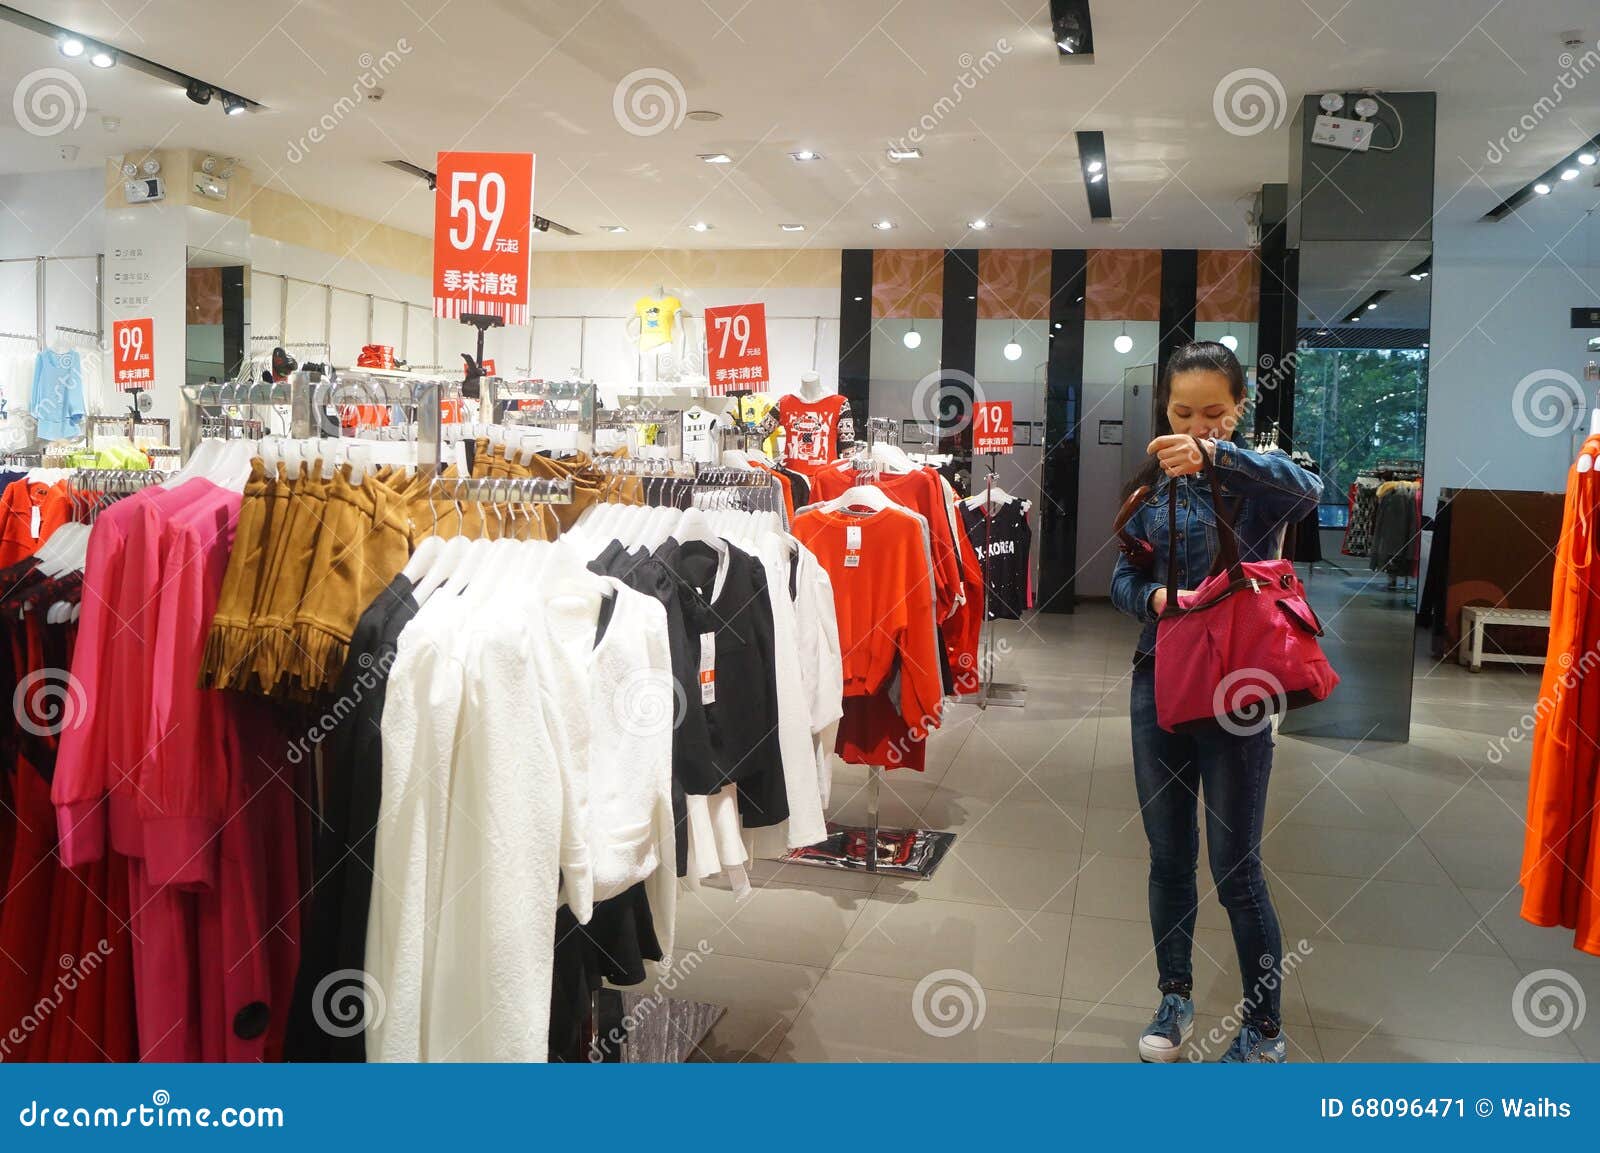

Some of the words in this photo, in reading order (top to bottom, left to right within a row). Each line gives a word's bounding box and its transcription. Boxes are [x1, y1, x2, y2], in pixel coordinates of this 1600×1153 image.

[449, 171, 506, 251] 59
[495, 238, 519, 253] 元起
[443, 269, 518, 296] 季末清货
[119, 326, 143, 362] 99
[714, 314, 751, 359] 79
[715, 365, 763, 382] 季末清货
[980, 405, 1002, 433] 19
